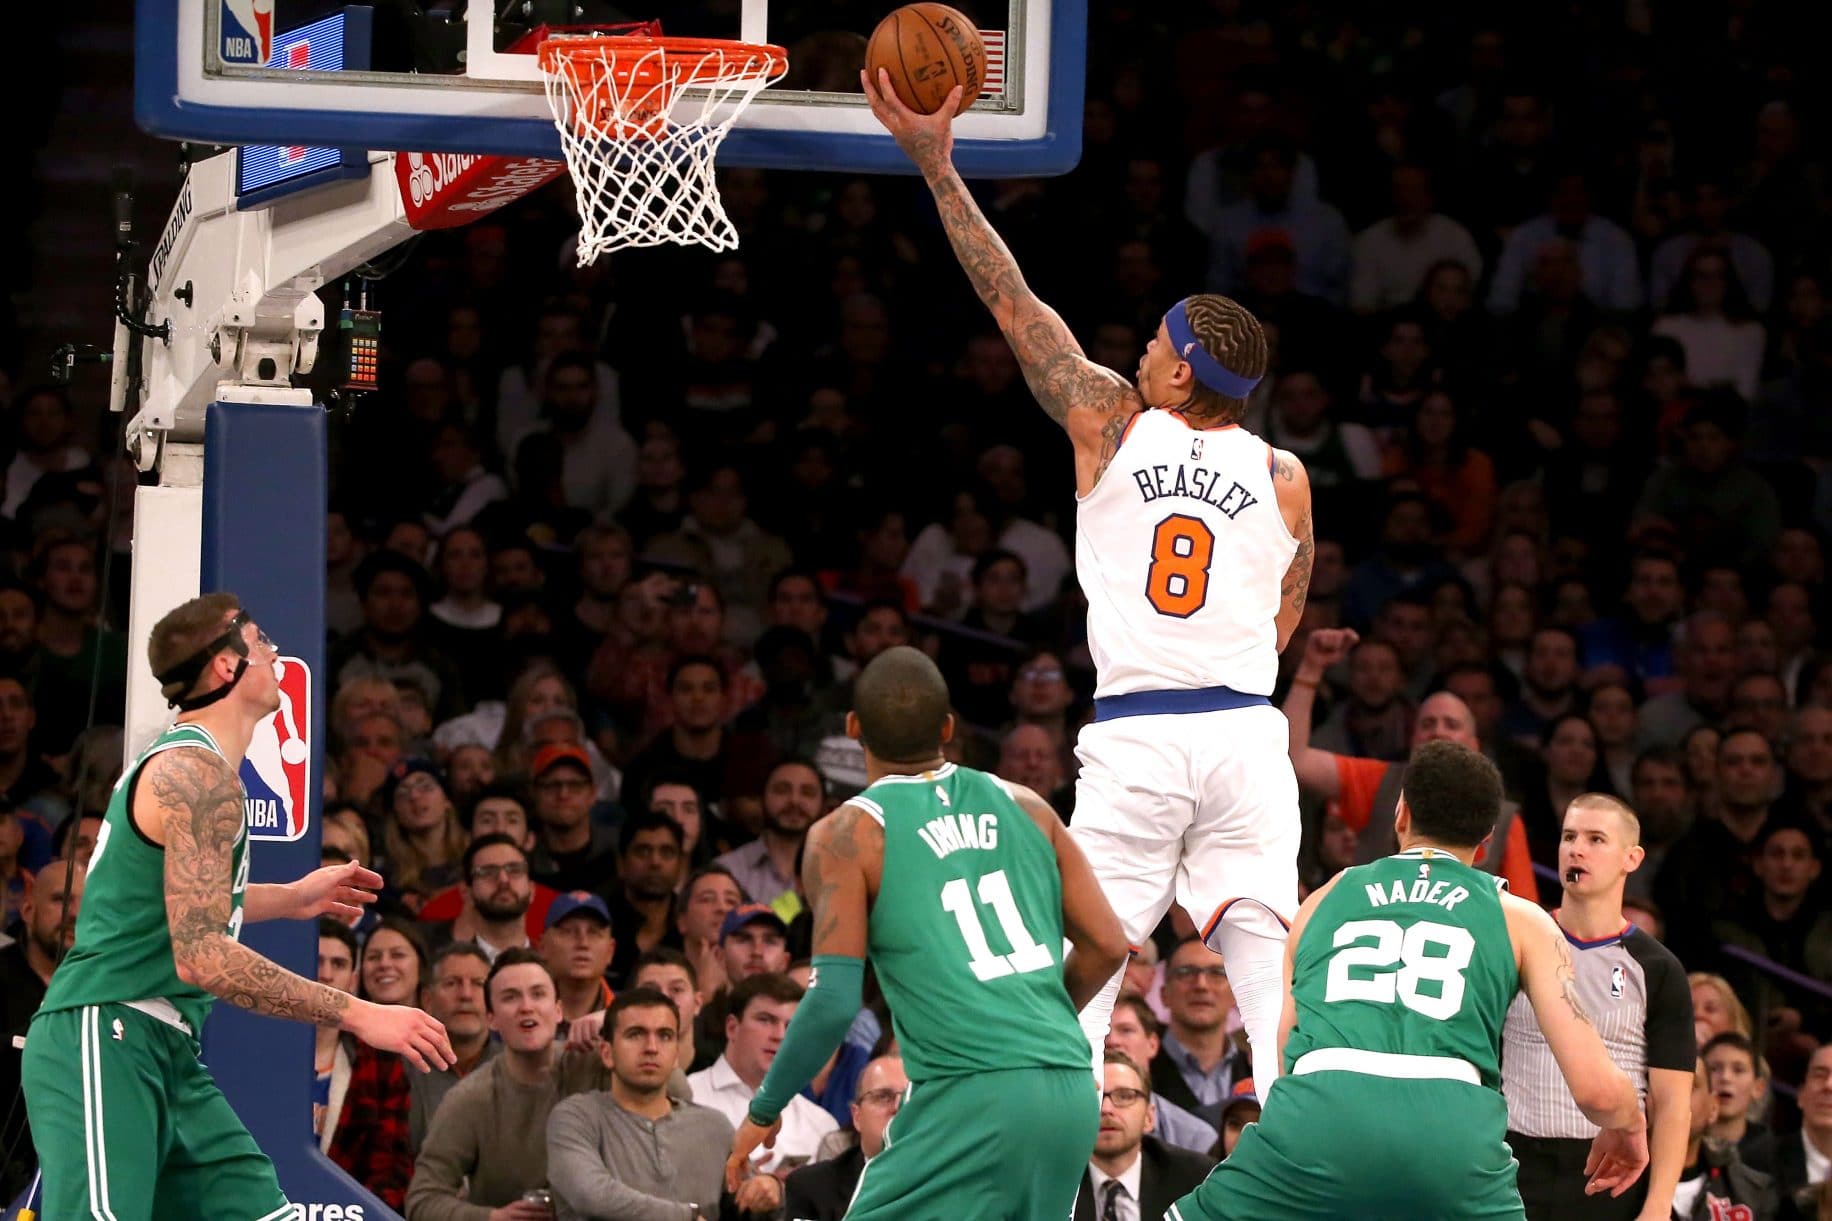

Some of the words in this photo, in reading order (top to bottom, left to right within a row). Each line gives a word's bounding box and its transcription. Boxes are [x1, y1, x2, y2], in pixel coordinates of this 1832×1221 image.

[226, 37, 252, 58] NBA
[153, 176, 192, 292] SPALDING
[1132, 464, 1258, 520] BEASLEY
[1145, 512, 1215, 619] 8
[940, 869, 1055, 982] 11
[1364, 879, 1470, 911] NADER
[1324, 919, 1476, 1021] 28
[290, 1202, 364, 1221] ares
